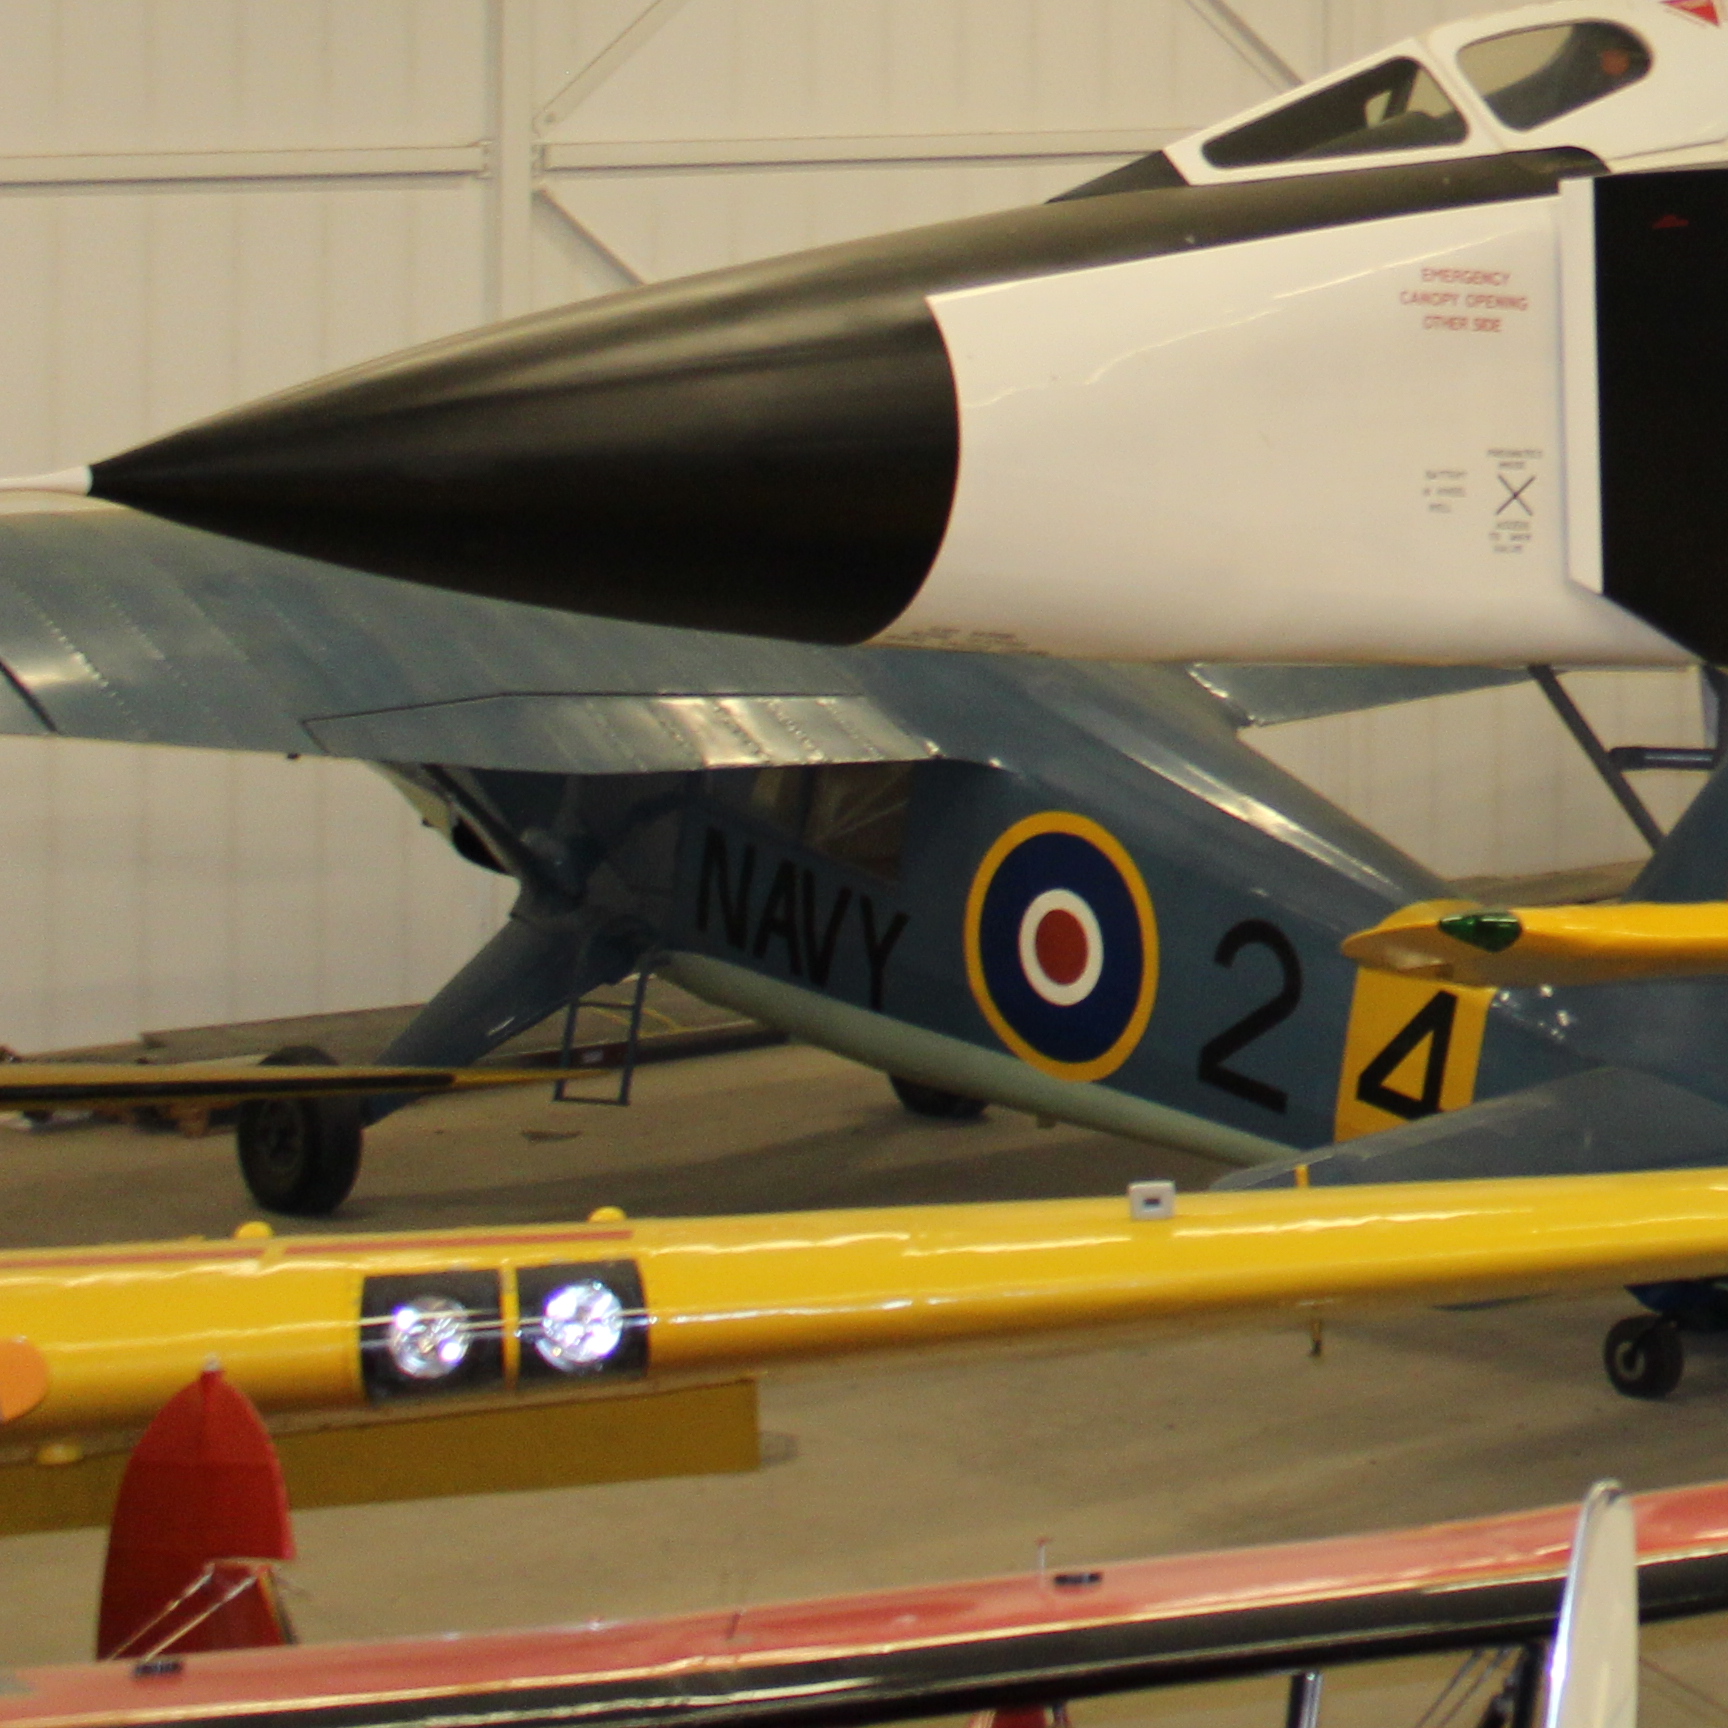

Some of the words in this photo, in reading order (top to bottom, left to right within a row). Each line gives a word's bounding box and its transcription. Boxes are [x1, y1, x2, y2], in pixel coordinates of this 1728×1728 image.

[1421, 267, 1512, 286] EMERGENCY
[1400, 290, 1460, 306] CANOPY
[1465, 293, 1529, 311] OPENING
[1423, 315, 1469, 330] OTHER
[1472, 317, 1503, 333] SIDE
[696, 827, 911, 1009] NAVY
